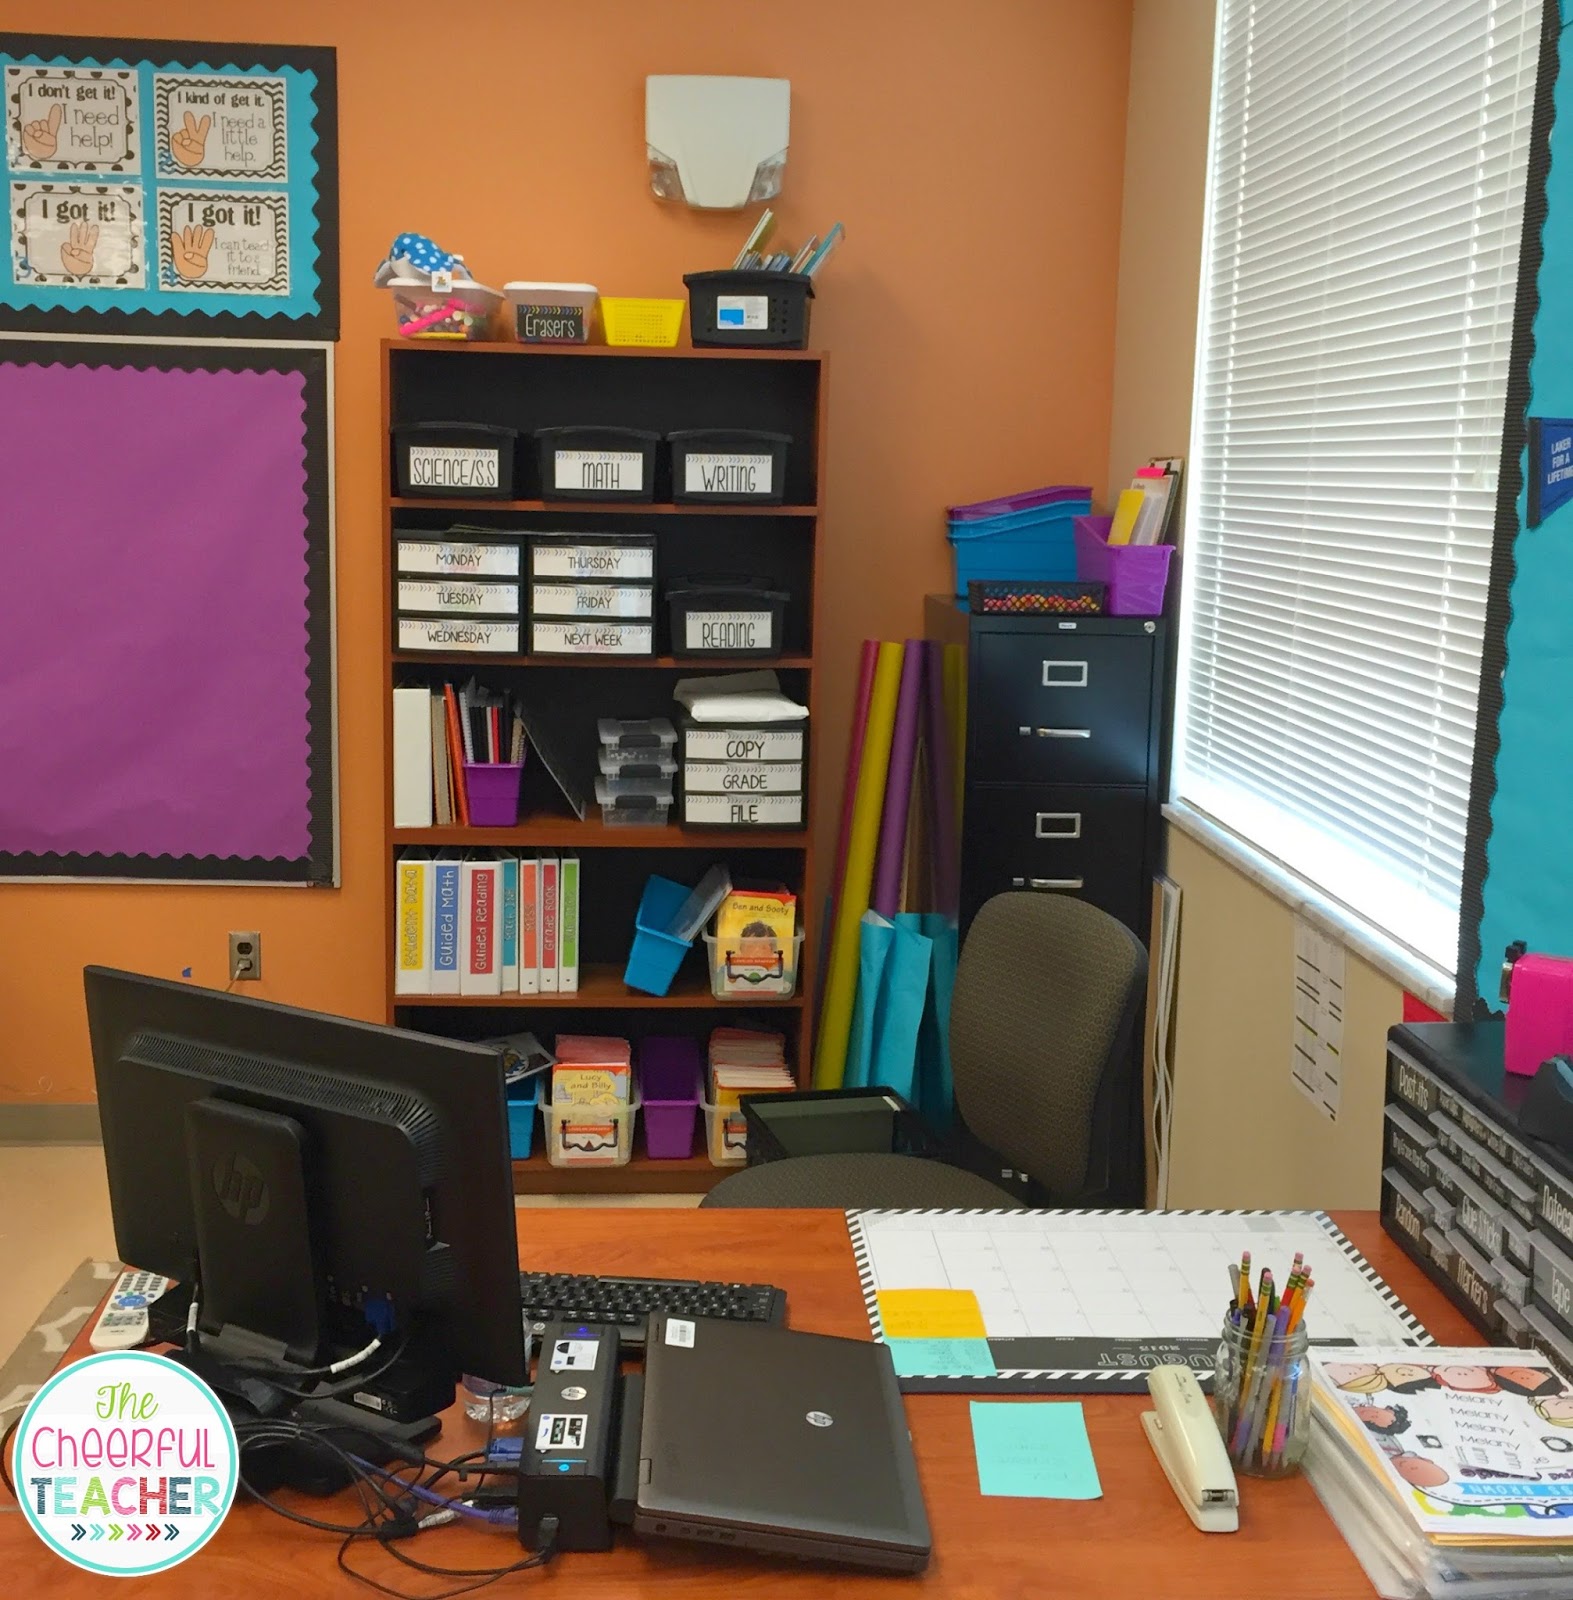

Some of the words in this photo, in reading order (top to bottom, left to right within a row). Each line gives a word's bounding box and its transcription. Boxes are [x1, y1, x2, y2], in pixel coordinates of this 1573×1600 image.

[28, 83, 33, 97] I
[38, 83, 70, 99] don't
[76, 85, 98, 101] get
[103, 86, 116, 100] it!
[178, 91, 182, 103] I
[185, 91, 209, 105] kind
[214, 93, 225, 105] of
[231, 94, 250, 108] get
[254, 94, 265, 107] it.
[62, 103, 67, 124] I
[74, 105, 119, 125] need
[212, 111, 216, 128] I
[221, 113, 255, 129] need
[257, 118, 266, 129] a
[70, 126, 114, 155] help!
[221, 128, 258, 145] little
[224, 145, 257, 168] help.
[42, 199, 48, 219] I
[56, 201, 90, 224] got
[98, 200, 116, 222] it!
[188, 203, 194, 223] I
[202, 204, 235, 227] got
[243, 205, 261, 226] it!
[220, 240, 240, 251] can
[227, 250, 235, 262] it
[239, 251, 252, 263] to
[525, 314, 575, 338] Erasers
[582, 462, 620, 489] MATH
[701, 465, 756, 492] WRITING
[436, 553, 482, 567] MONDAY
[568, 557, 620, 570] THURSDAY
[436, 592, 483, 605] TUESDAY
[577, 596, 612, 609] FRIDAY
[427, 631, 491, 644] WEDNESDAY
[564, 634, 591, 646] NEXT
[595, 634, 622, 647] WEEK
[702, 622, 755, 648] READING
[726, 740, 765, 759] COPY
[723, 774, 768, 790] GRADE
[731, 805, 758, 823] FILE
[441, 870, 454, 908] Math
[476, 873, 489, 922] Reading
[732, 902, 747, 910] Ben
[749, 903, 763, 912] and
[766, 904, 789, 915] Sooty
[440, 914, 454, 966] Guided
[474, 927, 488, 970] Guided
[580, 1073, 602, 1081] Lucy
[592, 1082, 611, 1090] Billy
[1398, 1065, 1429, 1111] Post-its
[1462, 1195, 1478, 1234] Glue
[1457, 1256, 1489, 1315] Markers
[1551, 1267, 1571, 1314] Tape
